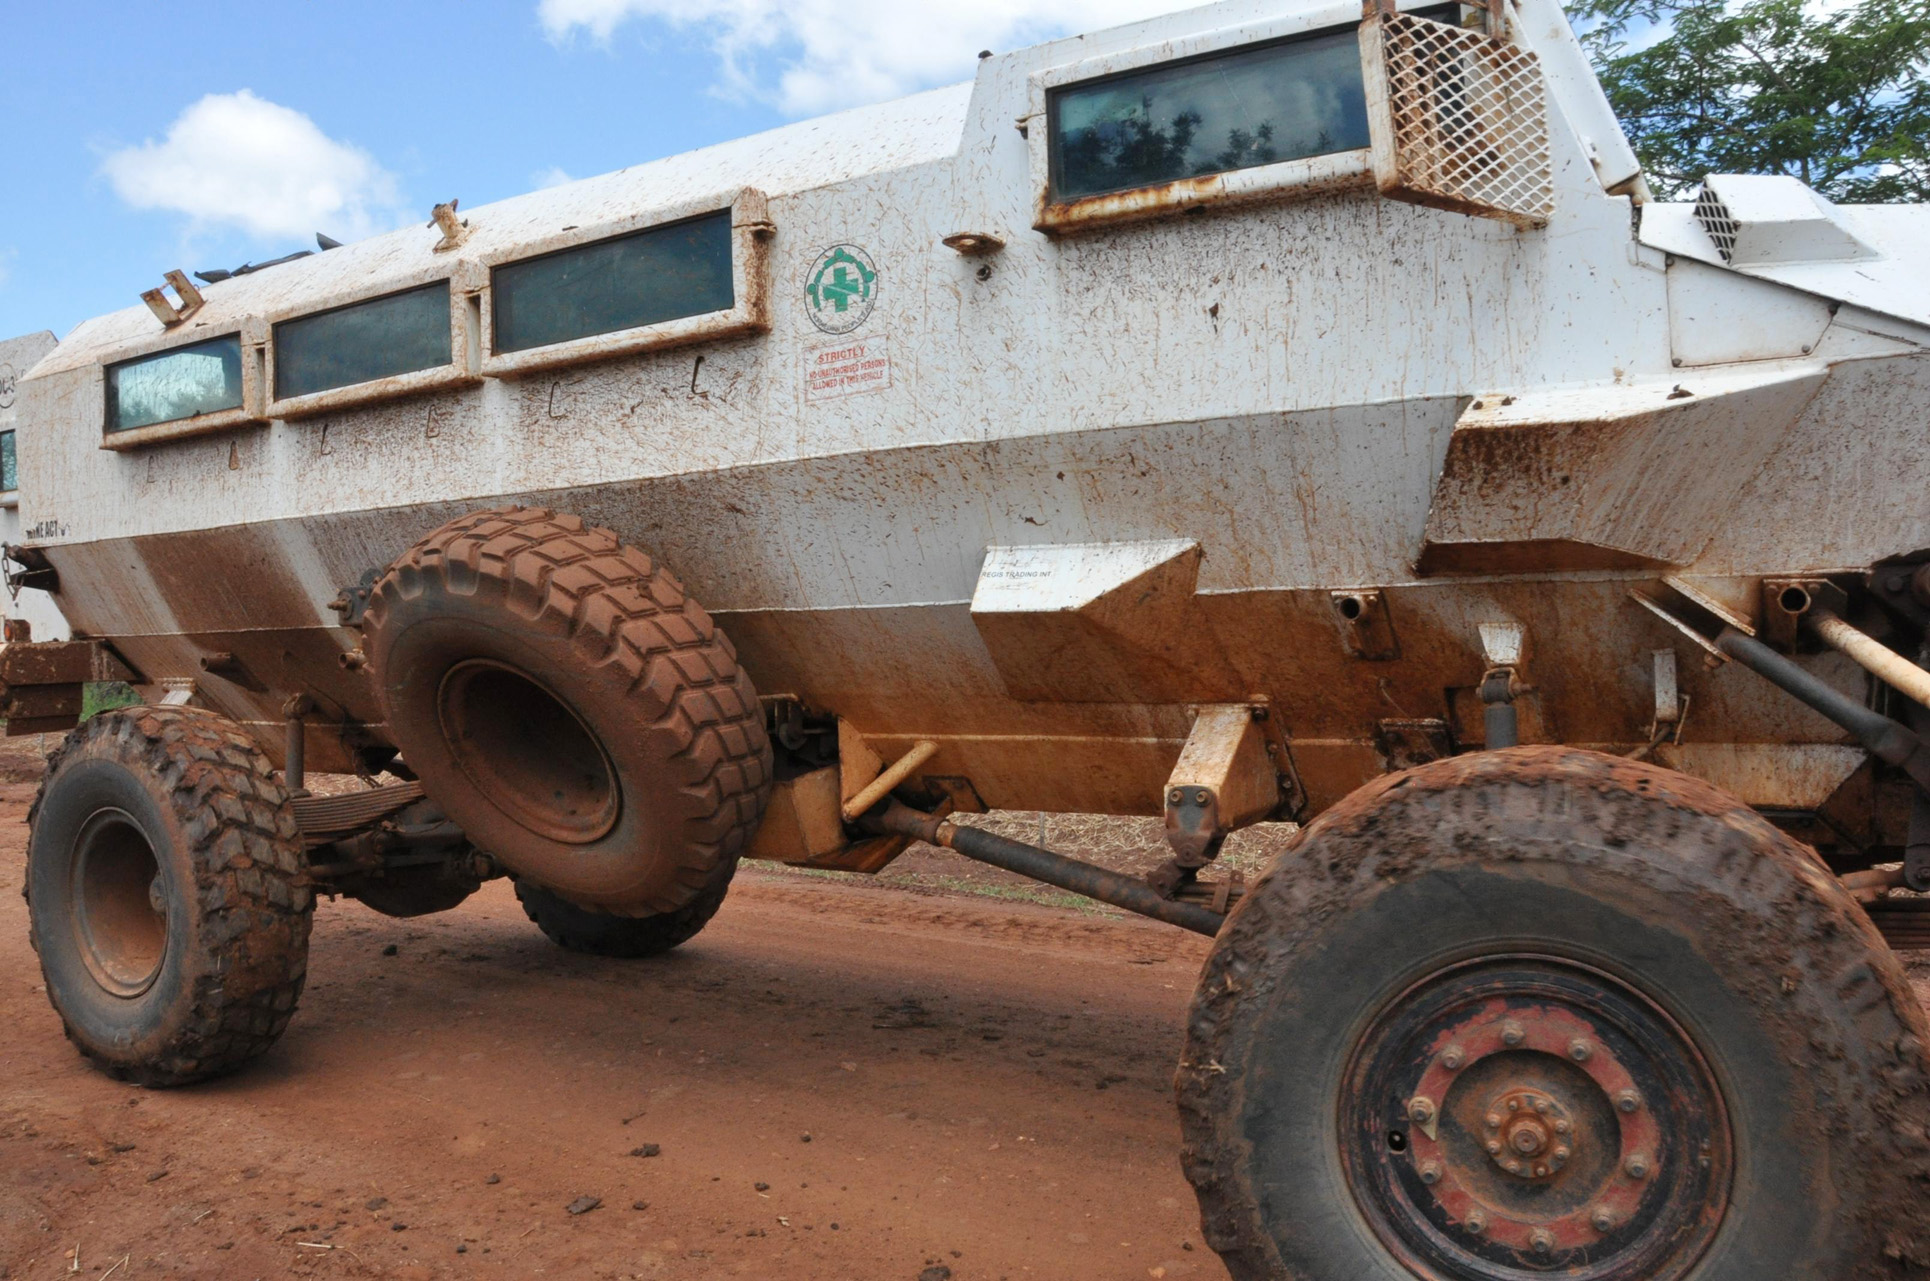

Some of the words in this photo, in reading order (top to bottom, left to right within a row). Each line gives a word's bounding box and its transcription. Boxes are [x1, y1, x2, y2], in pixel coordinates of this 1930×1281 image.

[818, 346, 865, 363] STRICTLY
[809, 370, 817, 379] NO
[861, 358, 886, 370] PERSONS
[812, 378, 837, 390] ALLOWED
[860, 370, 883, 381] VEHICLE
